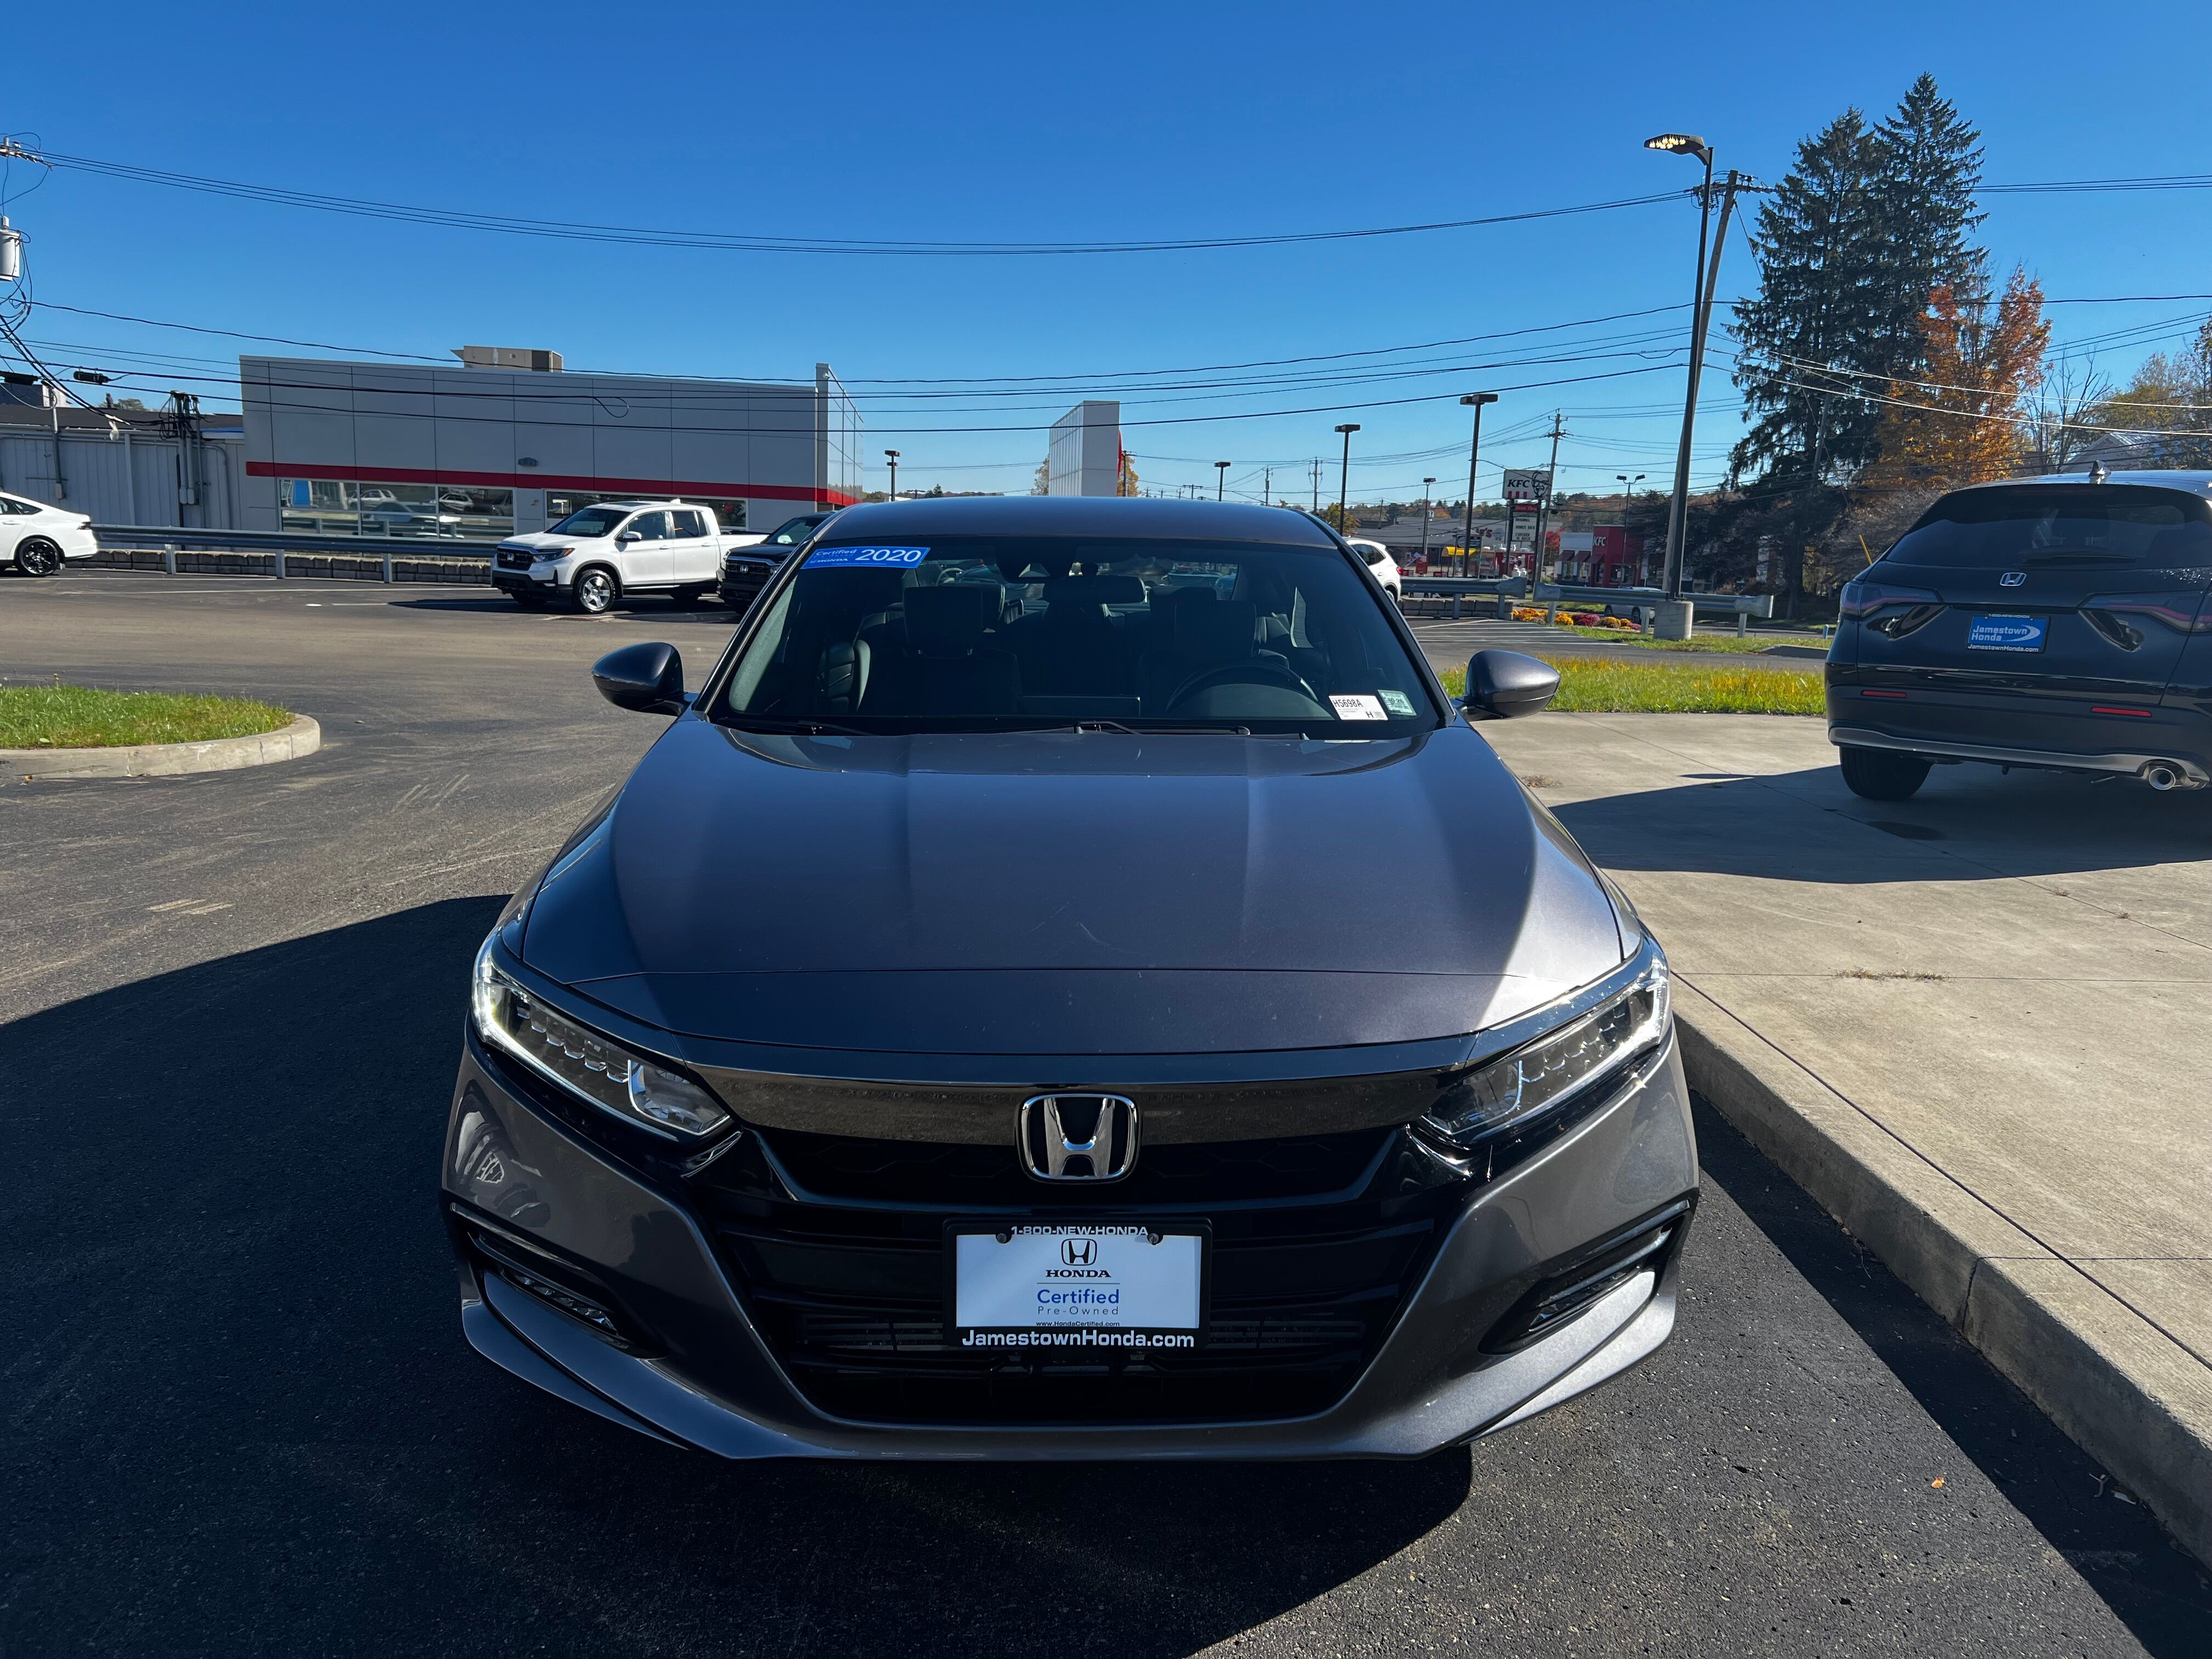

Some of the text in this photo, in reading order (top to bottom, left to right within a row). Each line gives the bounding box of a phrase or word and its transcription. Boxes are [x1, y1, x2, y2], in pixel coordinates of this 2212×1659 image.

[1507, 479, 1530, 488] KFC
[1593, 536, 1606, 547] KFC
[855, 549, 922, 562] 2020
[1973, 625, 2027, 635] Jamestown
[1971, 633, 2002, 641] Honda
[1333, 699, 1363, 708] H5698A
[1011, 1226, 1149, 1235] 1-800-NEW-HONDA
[1046, 1269, 1111, 1278] HONDA
[1037, 1289, 1120, 1304] Certified
[1038, 1306, 1119, 1315] Pre-Owned
[962, 1330, 1194, 1347] JamestownHonda.com
